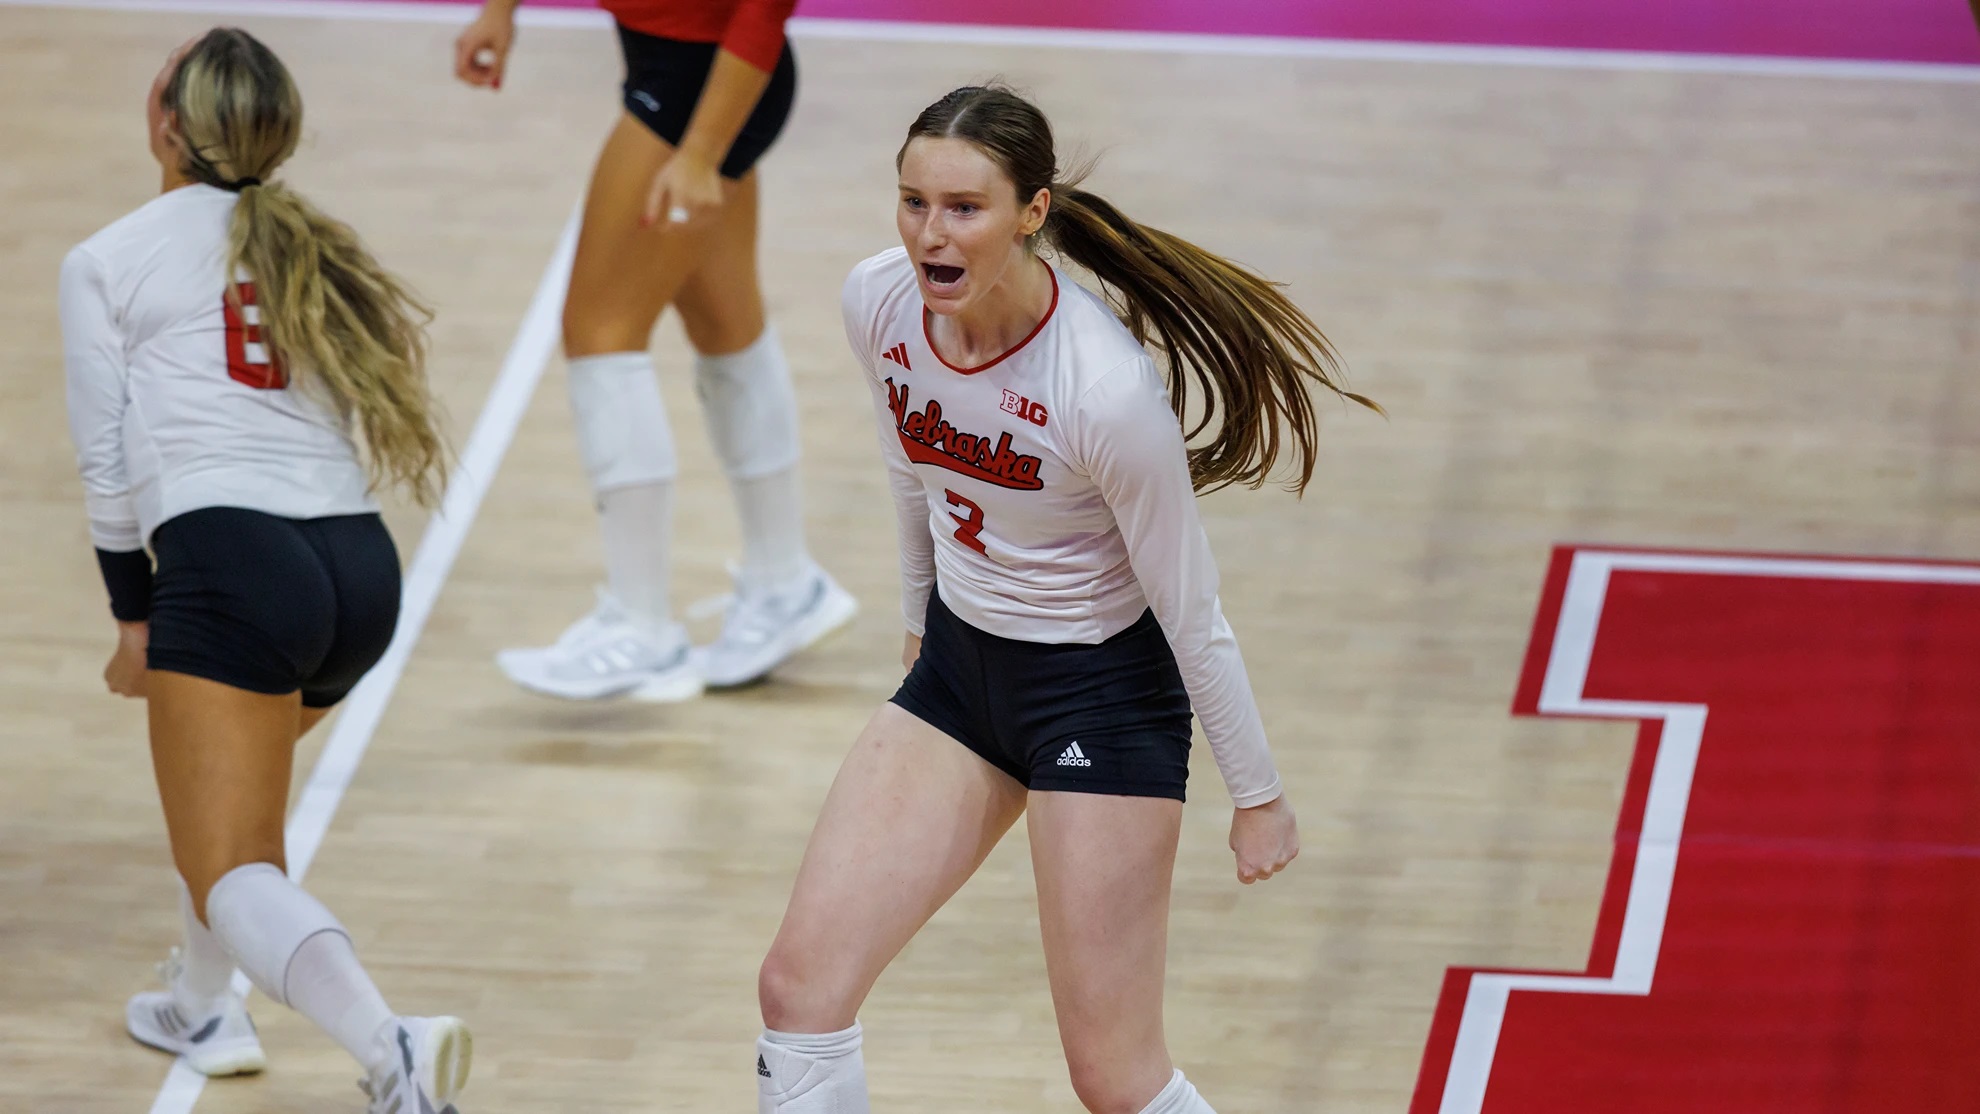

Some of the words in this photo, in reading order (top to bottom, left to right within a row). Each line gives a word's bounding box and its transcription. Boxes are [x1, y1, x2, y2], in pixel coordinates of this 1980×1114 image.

[885, 376, 1044, 488] Nebraska
[944, 488, 989, 558] 2
[1056, 756, 1092, 767] adidas
